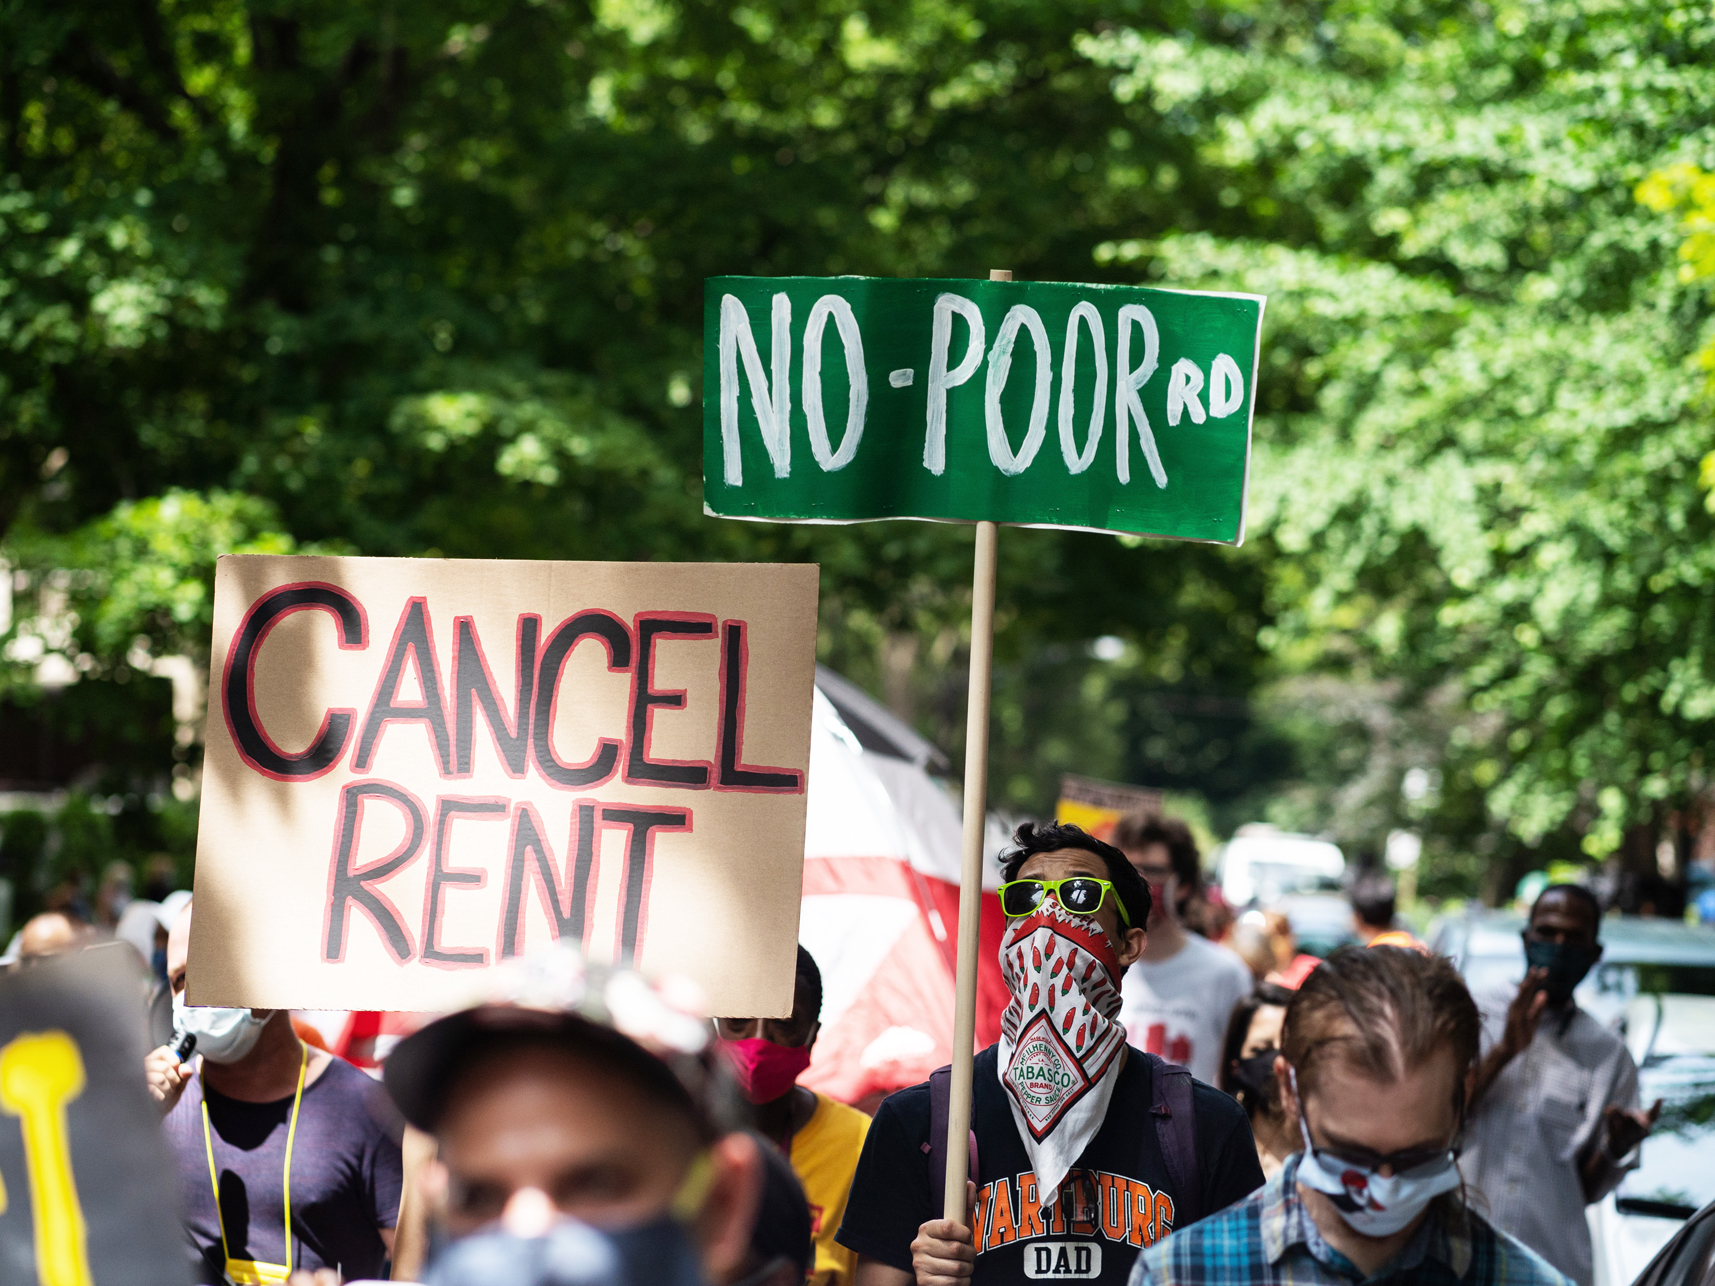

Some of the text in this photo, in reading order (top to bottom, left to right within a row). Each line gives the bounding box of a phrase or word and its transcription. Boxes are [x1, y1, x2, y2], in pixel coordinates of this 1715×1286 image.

[1167, 353, 1245, 426] RD
[222, 581, 805, 794] CANCEL
[321, 778, 693, 970] RENT
[1013, 1065, 1071, 1088] TABASCO
[1030, 1082, 1053, 1090] BRAND
[1019, 1081, 1042, 1104] PEPPER
[1044, 1086, 1061, 1105] SAUCE
[1034, 1247, 1092, 1275] DAD
